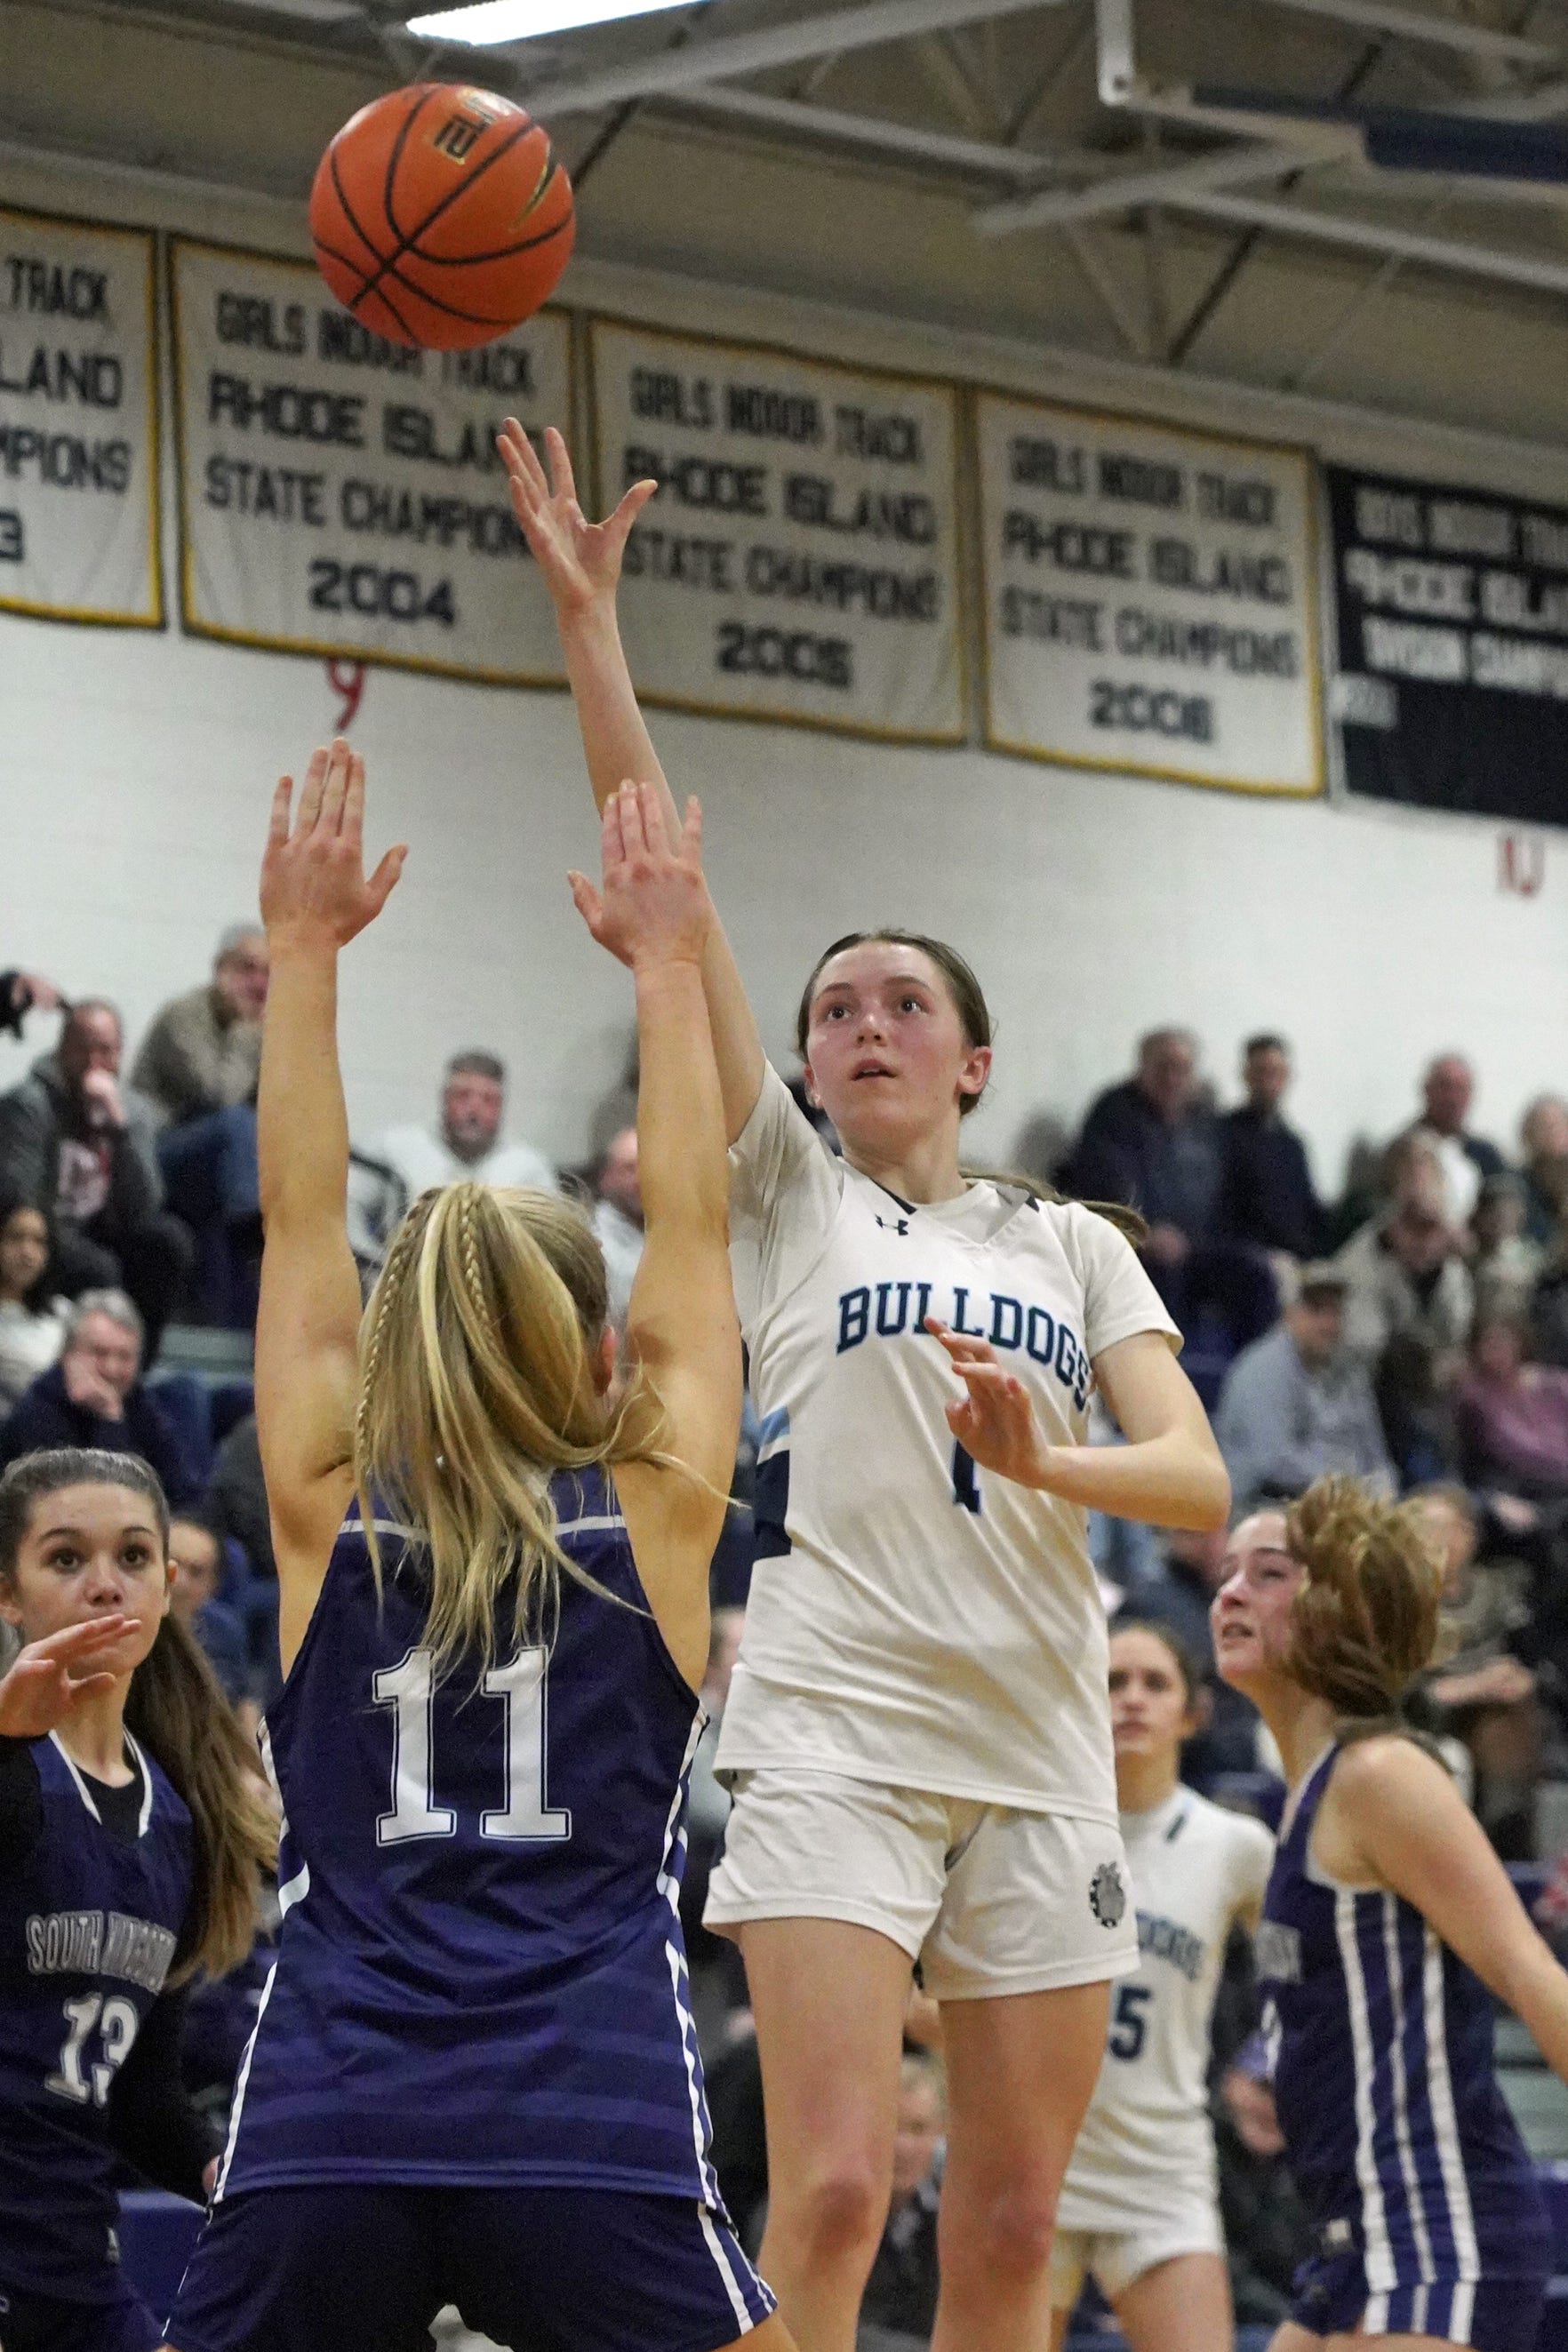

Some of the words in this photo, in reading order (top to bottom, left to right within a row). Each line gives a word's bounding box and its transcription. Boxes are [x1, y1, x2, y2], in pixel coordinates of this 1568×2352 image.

[208, 370, 366, 448] RHODE
[204, 454, 329, 529] STATE
[309, 556, 458, 629] 2004
[836, 1282, 1089, 1412] BULLDOGS
[372, 1645, 572, 1847] 11
[26, 1910, 104, 1976] SOUTH
[1109, 1983, 1151, 2063] 5
